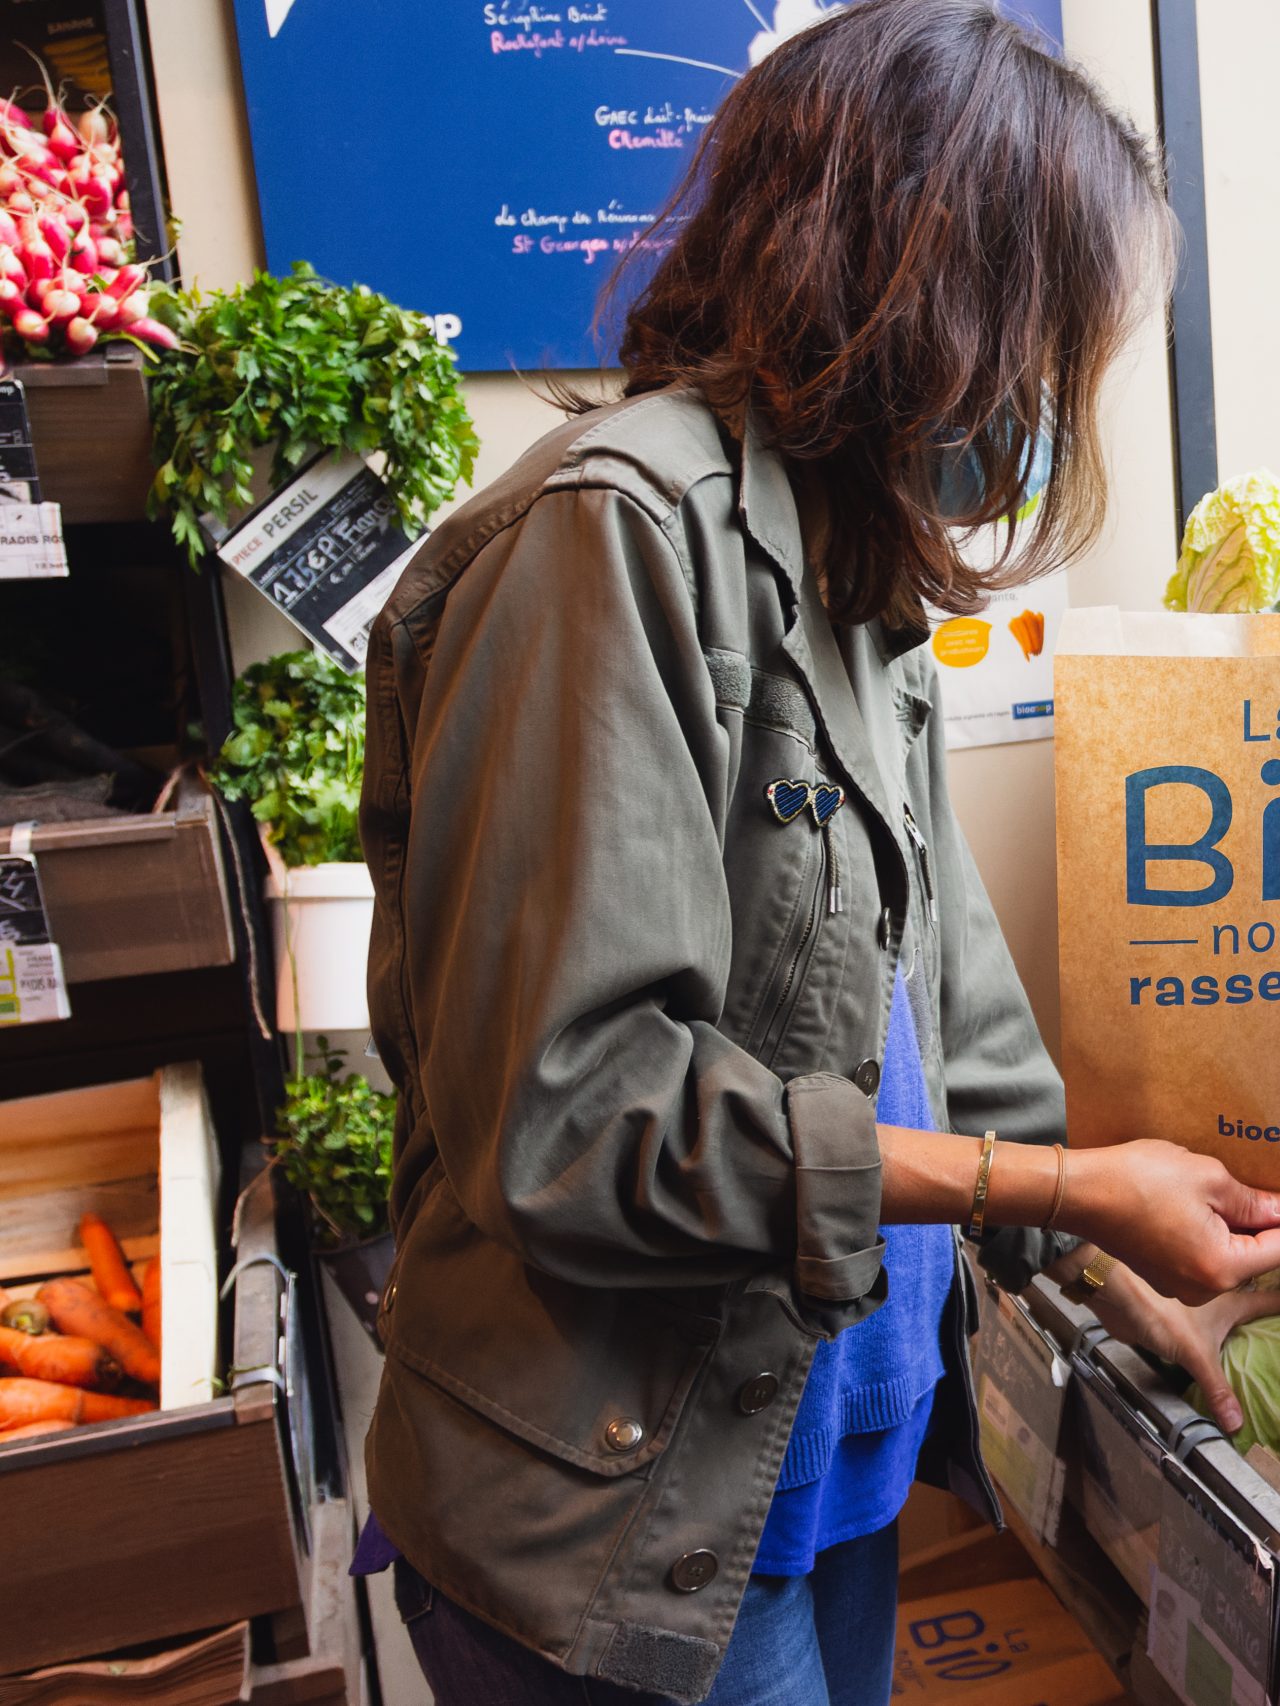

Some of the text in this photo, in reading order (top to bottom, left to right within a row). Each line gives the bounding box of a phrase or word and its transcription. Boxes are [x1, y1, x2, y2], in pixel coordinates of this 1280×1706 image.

[491, 31, 564, 58] Rochefort
[595, 105, 638, 126] GAEC
[608, 124, 683, 149] Chemillé
[512, 234, 534, 254] St
[261, 488, 319, 538] PERSIL
[0, 535, 38, 545] RADIS
[909, 1609, 1012, 1682] BiO
